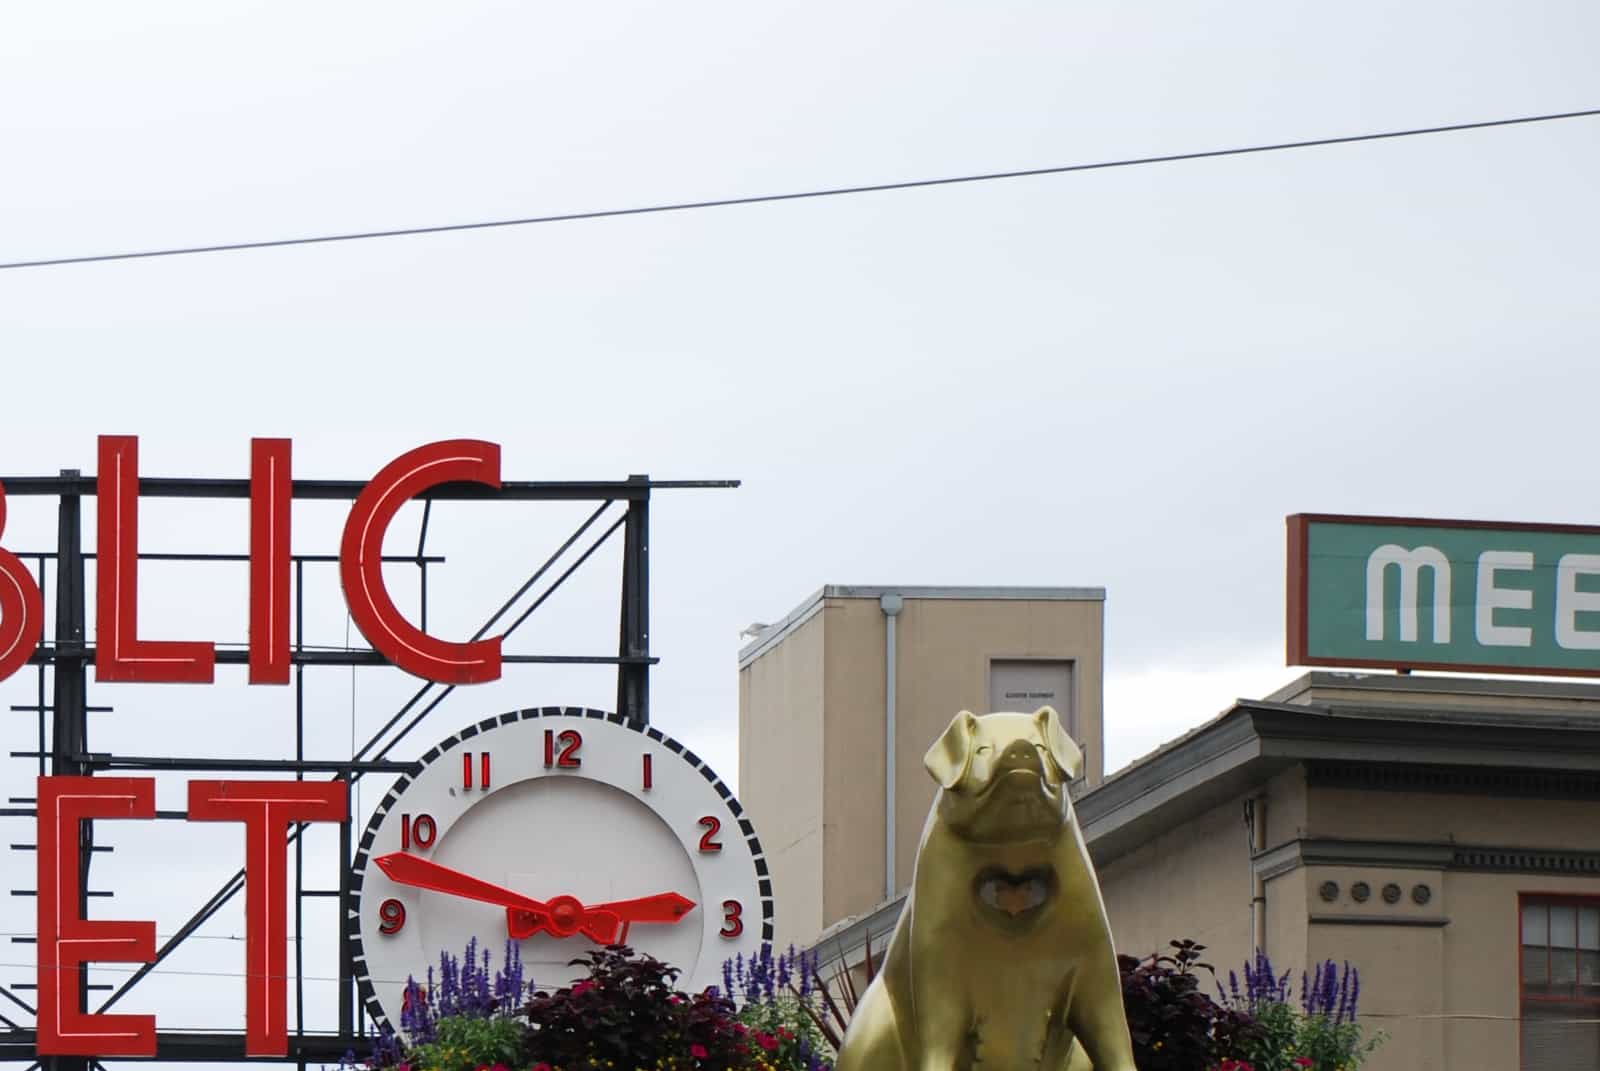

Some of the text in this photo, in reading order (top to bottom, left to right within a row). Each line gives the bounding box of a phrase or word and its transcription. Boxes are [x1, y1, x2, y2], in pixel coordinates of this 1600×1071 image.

[543, 729, 583, 768] 12
[462, 751, 491, 790] 11
[642, 753, 653, 790] 1
[400, 813, 438, 850] 10
[698, 815, 723, 852] 2
[378, 898, 407, 935] 9
[719, 900, 743, 938] 3
